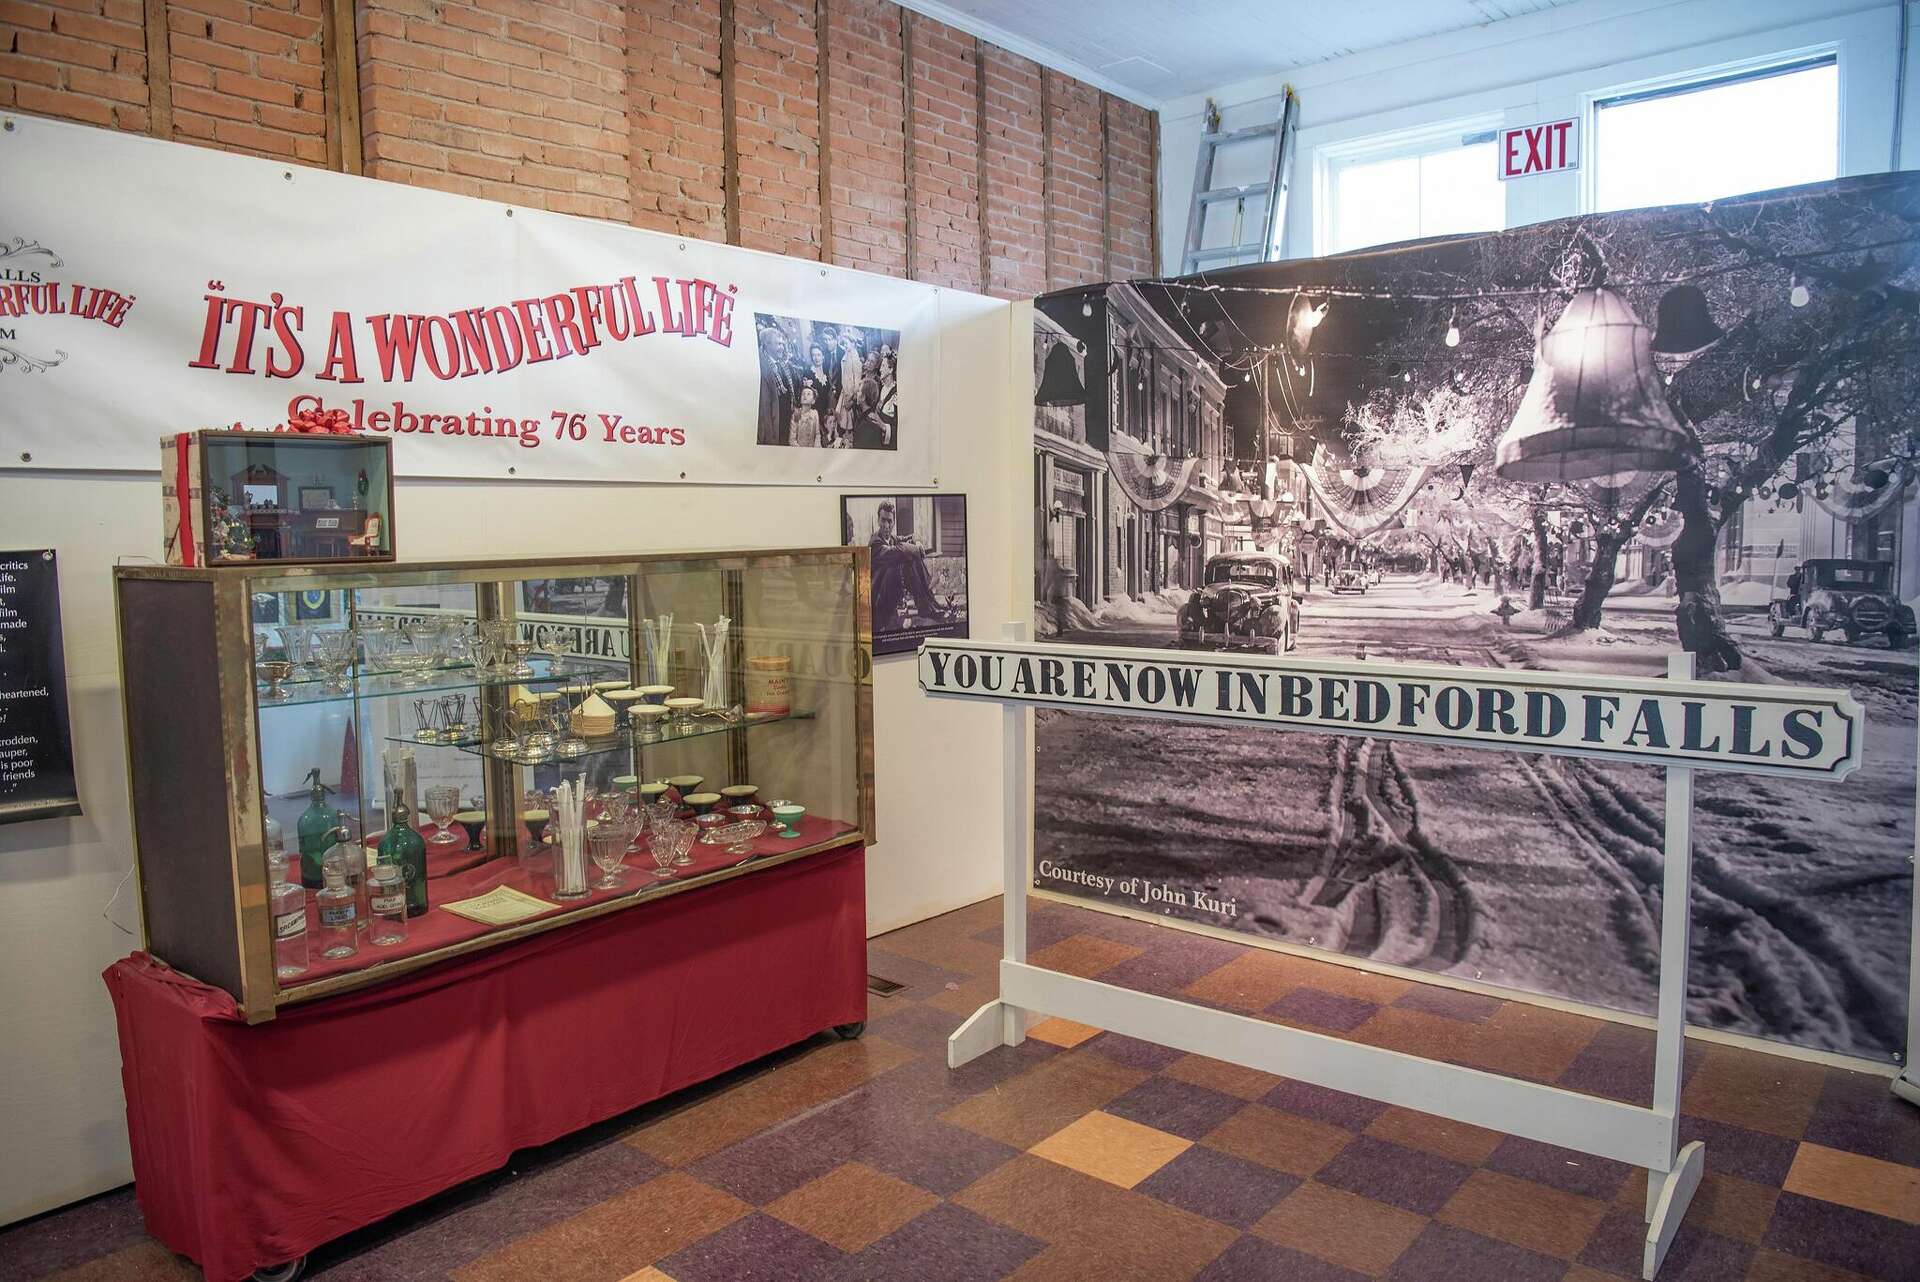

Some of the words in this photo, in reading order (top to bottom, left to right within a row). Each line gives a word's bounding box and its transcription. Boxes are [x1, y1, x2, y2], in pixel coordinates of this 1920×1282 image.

[1506, 121, 1573, 176] EXIT
[315, 311, 365, 383] A
[366, 276, 656, 382] WONDERFUL
[550, 410, 587, 441] 76
[598, 414, 686, 446] Years
[0, 561, 29, 570] critics
[0, 619, 28, 629] made
[928, 652, 1004, 693] YOU
[1011, 658, 1097, 700] ARE
[1104, 662, 1203, 708] NOW
[1215, 670, 1270, 715] IN
[1278, 674, 1567, 738] BEDFORD
[1580, 695, 1825, 761] FALLS
[3, 769, 36, 782] friends
[11, 760, 34, 771] poor
[1039, 860, 1115, 896] Courtesy
[1119, 877, 1140, 896] of
[1140, 880, 1187, 904] John
[1192, 890, 1238, 917] Kuri
